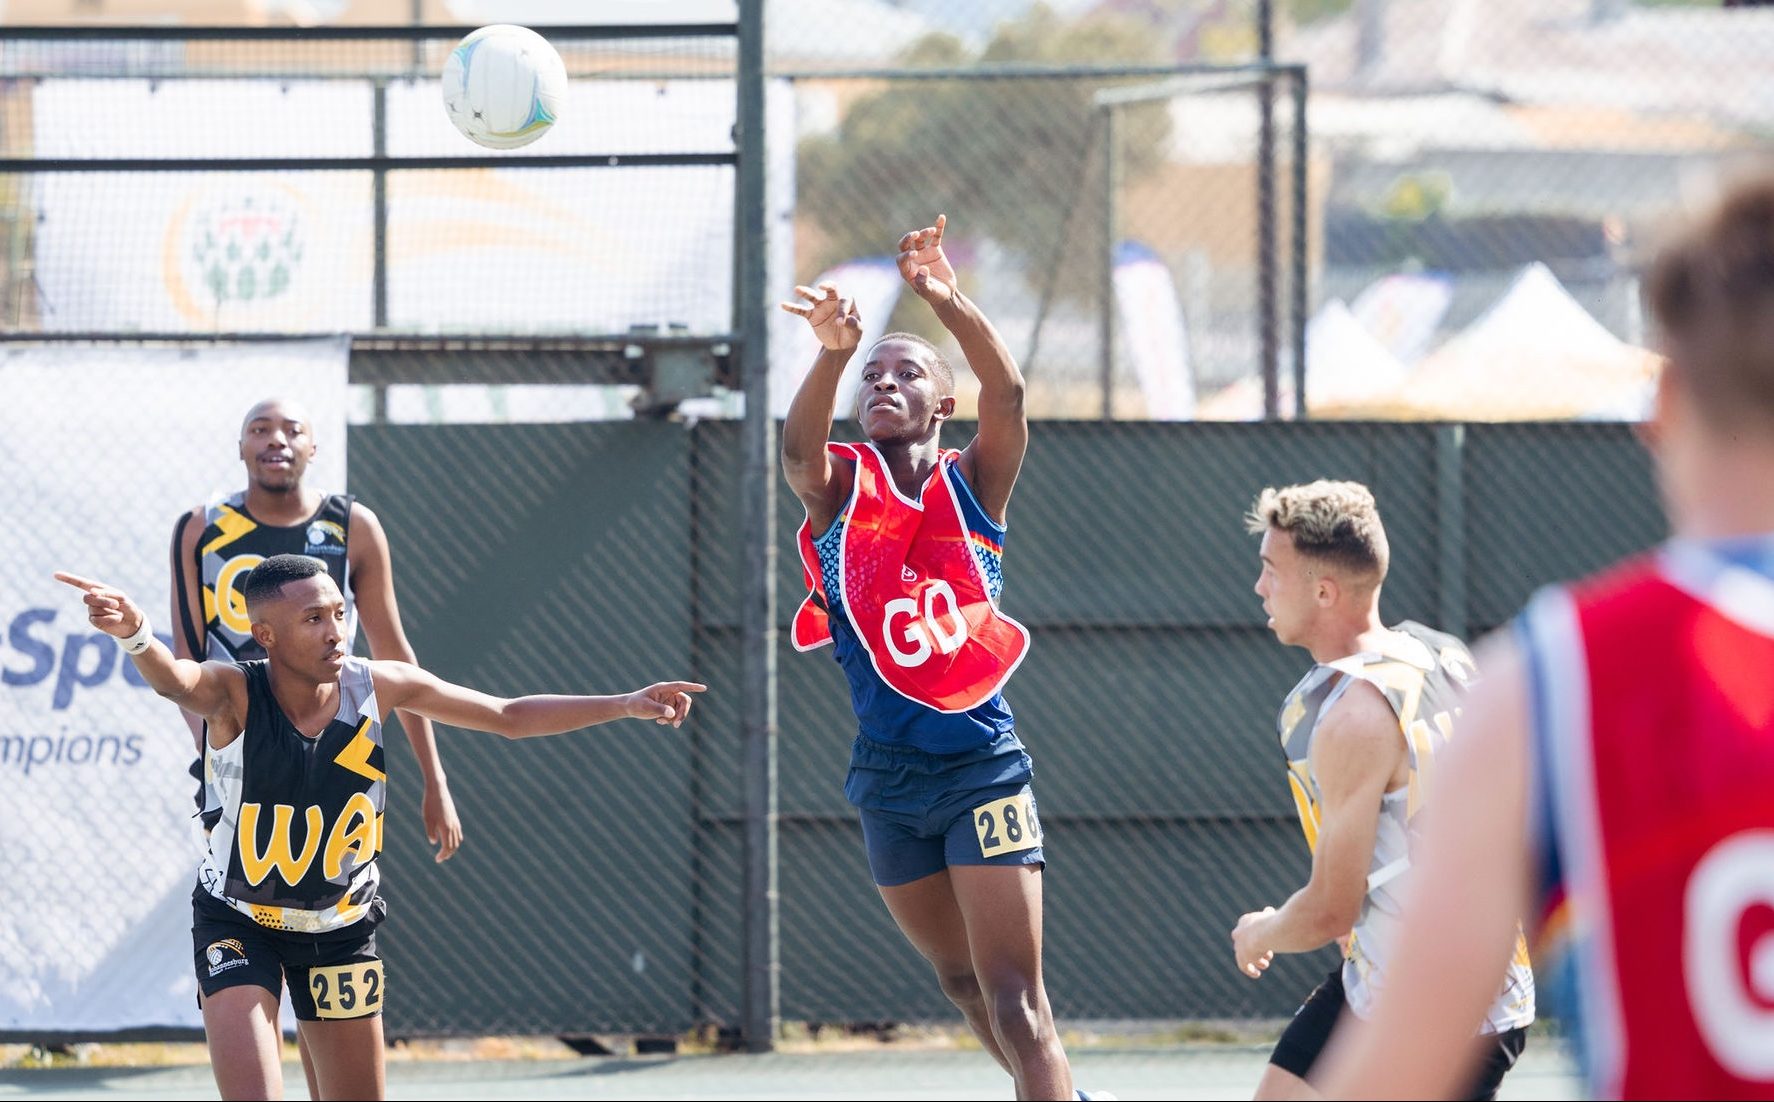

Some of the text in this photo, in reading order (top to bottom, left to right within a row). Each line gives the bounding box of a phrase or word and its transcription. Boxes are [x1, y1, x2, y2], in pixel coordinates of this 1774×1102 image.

[882, 579, 968, 667] GD
[238, 792, 376, 887] WA
[979, 804, 1038, 849] 286
[312, 968, 379, 1010] 252
